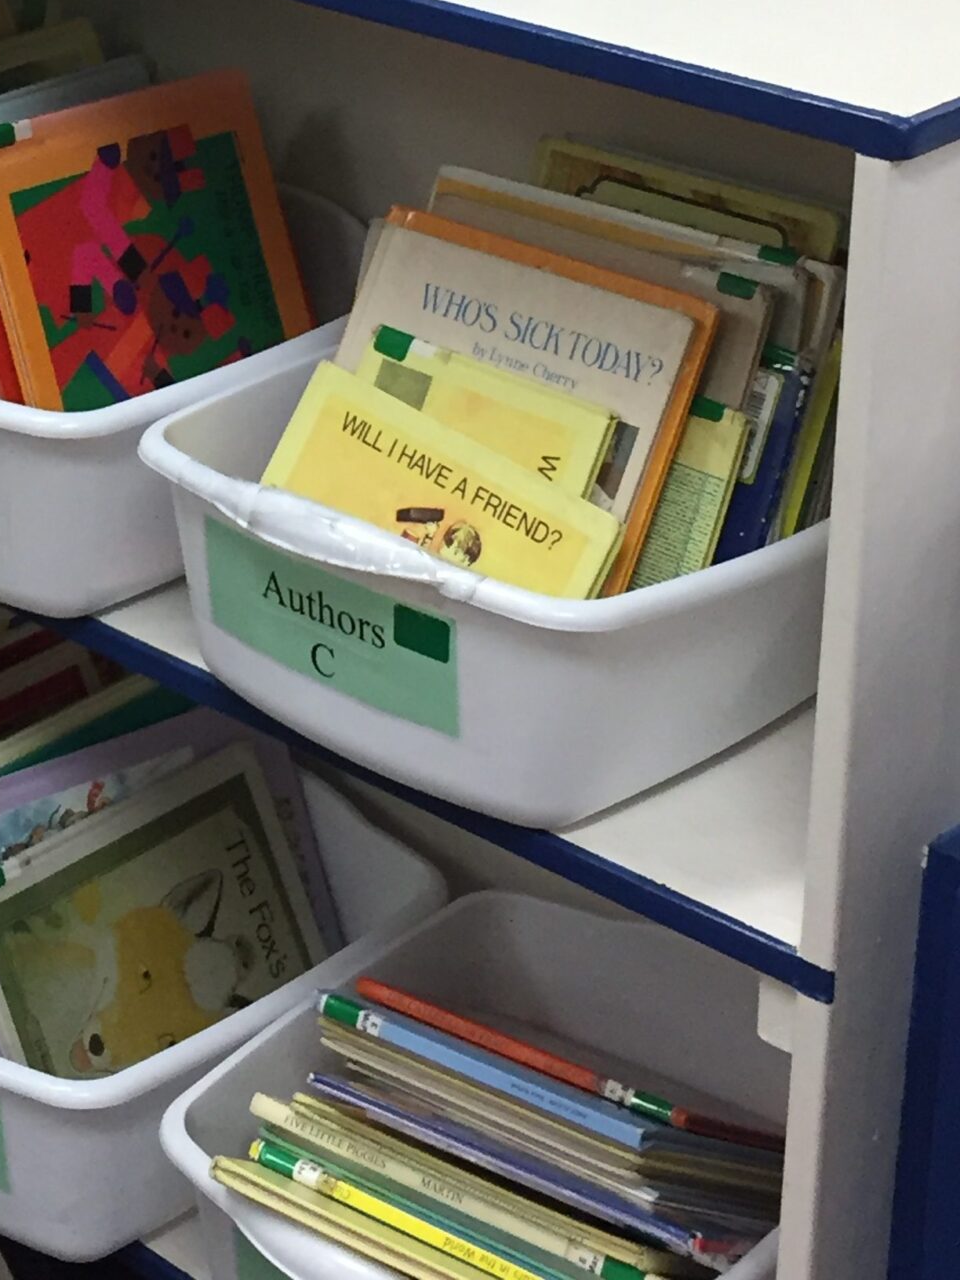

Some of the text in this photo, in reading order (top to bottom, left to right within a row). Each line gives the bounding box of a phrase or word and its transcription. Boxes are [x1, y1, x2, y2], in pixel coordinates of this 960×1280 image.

[422, 282, 665, 386] WHO'S SICK TODAY?
[471, 341, 579, 390] by Lynne Cherry
[341, 411, 563, 551] WILL I HAVE A FRIEND?
[262, 571, 386, 649] Authors
[311, 643, 335, 678] C
[225, 839, 288, 980] The Fox's
